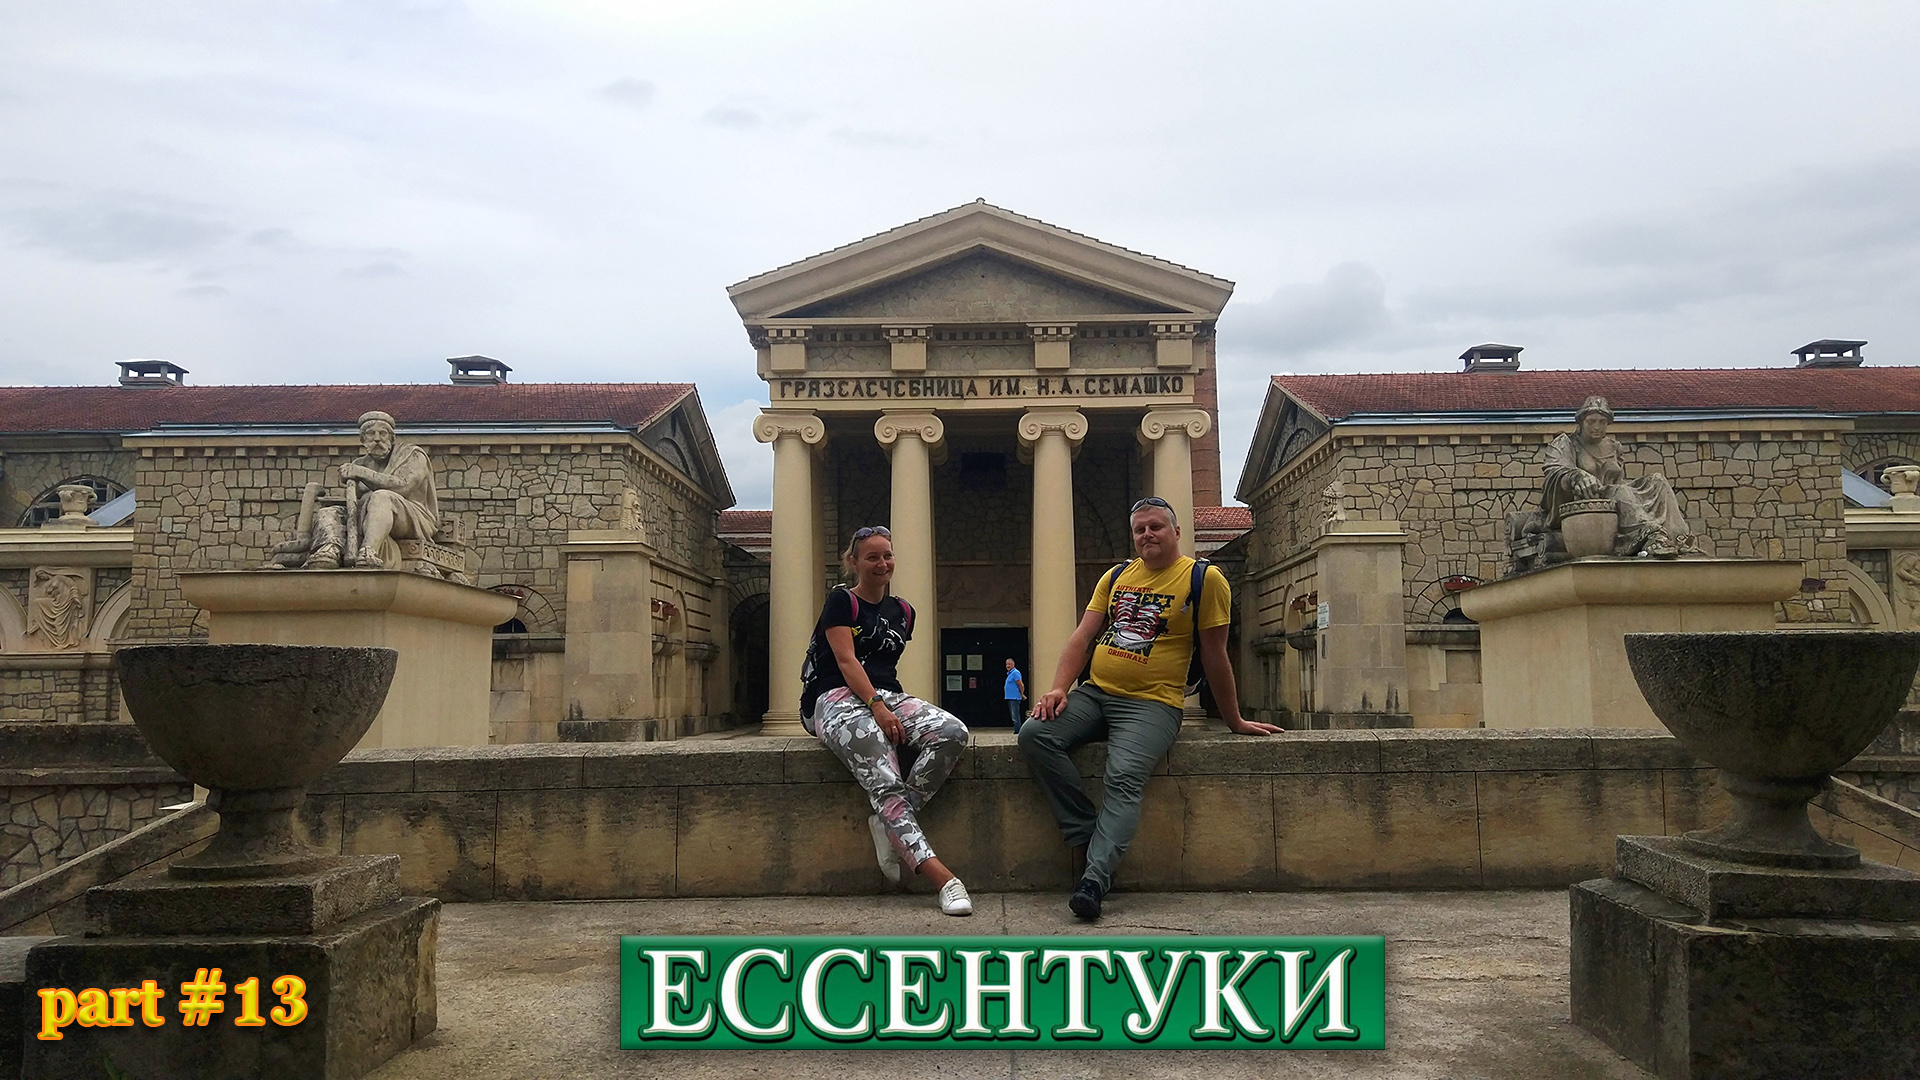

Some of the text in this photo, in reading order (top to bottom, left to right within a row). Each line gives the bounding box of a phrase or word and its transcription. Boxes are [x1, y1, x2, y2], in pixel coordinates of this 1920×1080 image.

[989, 377, 1026, 396] ИМ.
[1116, 585, 1154, 593] AUTHENTIC
[1107, 648, 1149, 665] ORIGINALS
